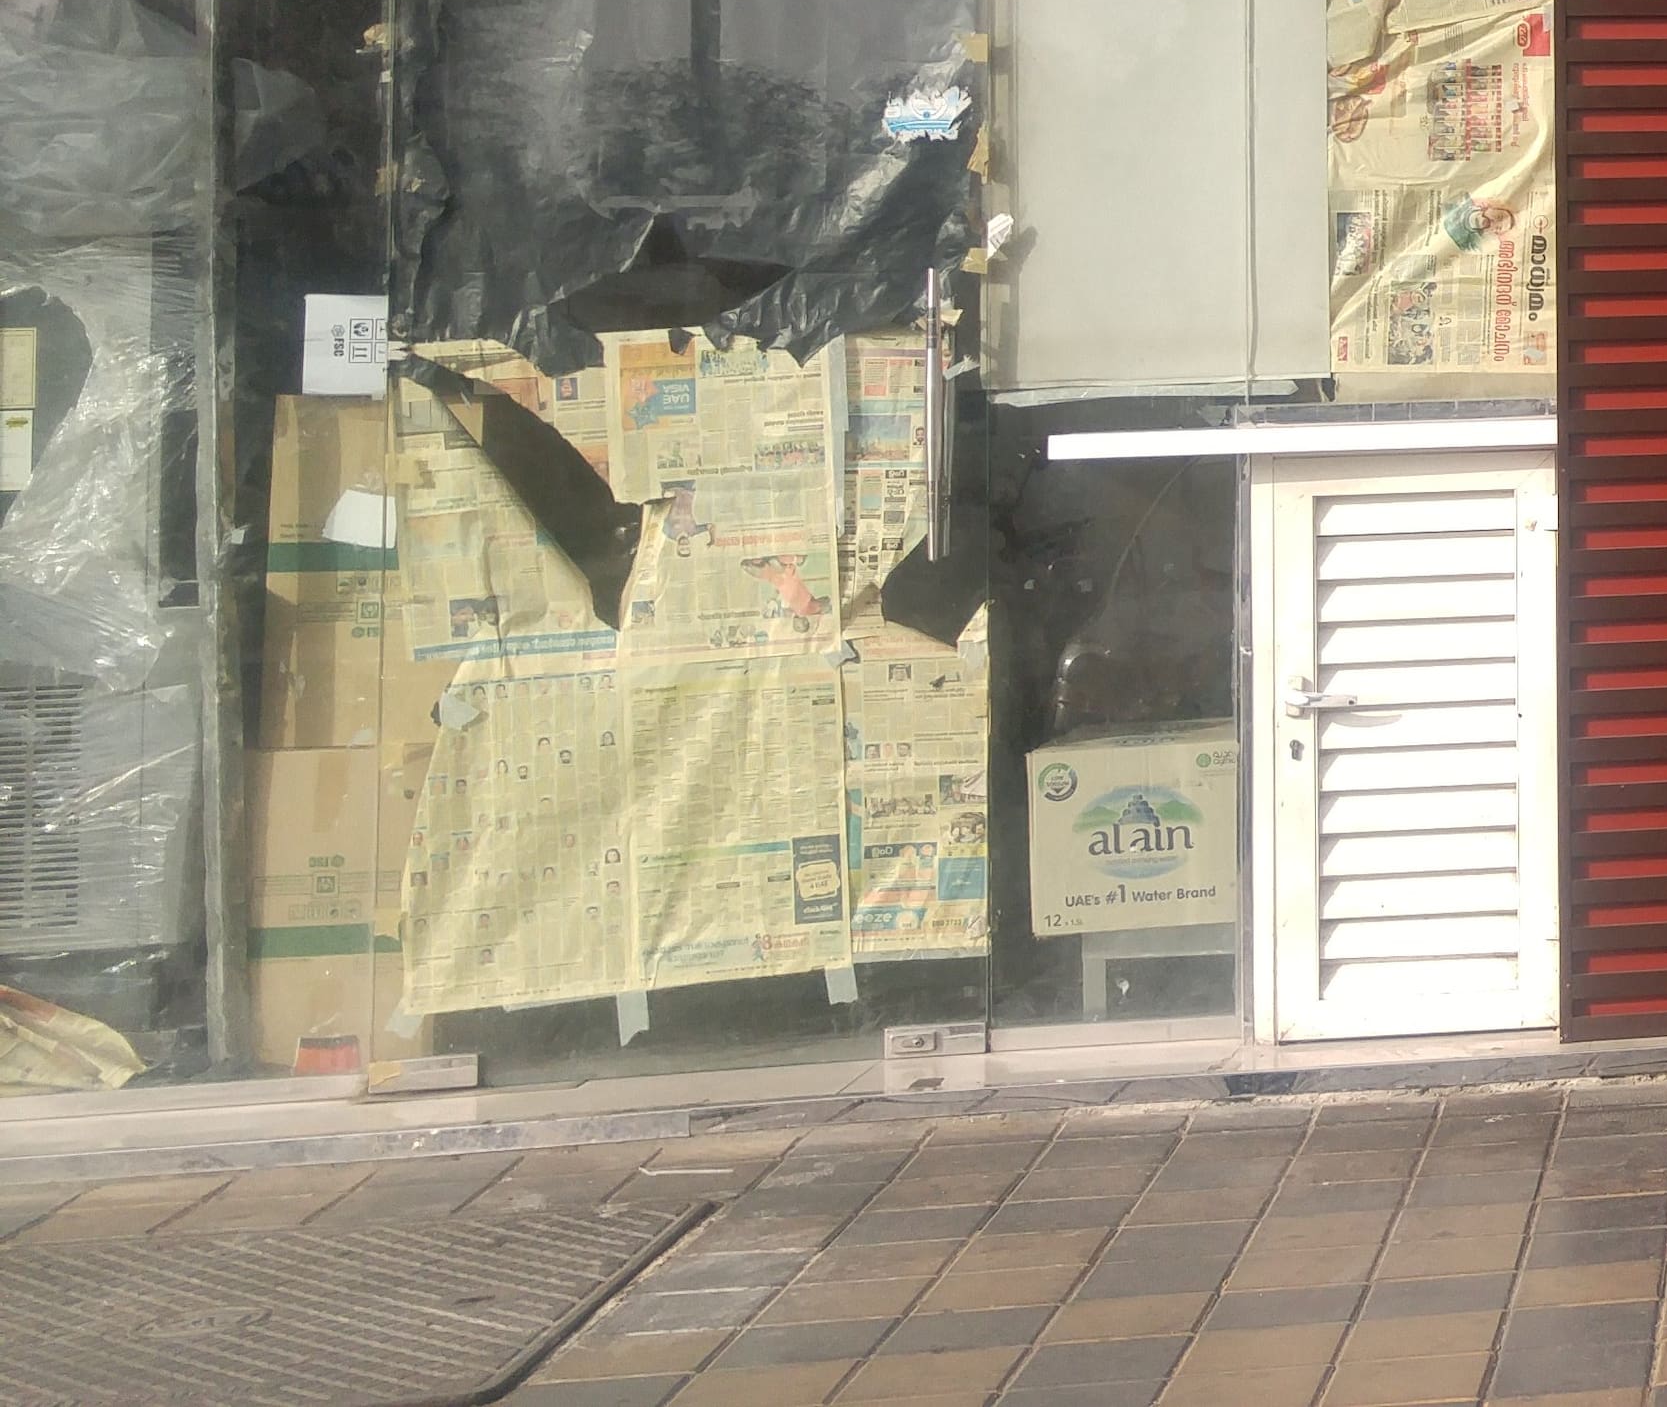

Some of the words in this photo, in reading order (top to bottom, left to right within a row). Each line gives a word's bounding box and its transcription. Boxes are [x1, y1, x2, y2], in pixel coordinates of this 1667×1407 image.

[1088, 823, 1124, 856] al
[1130, 823, 1194, 854] ain
[1065, 893, 1101, 908] UAE's
[1105, 884, 1127, 905] #1
[1132, 889, 1173, 903] Water
[1177, 886, 1217, 899] Brand
[1044, 914, 1062, 927] 12
